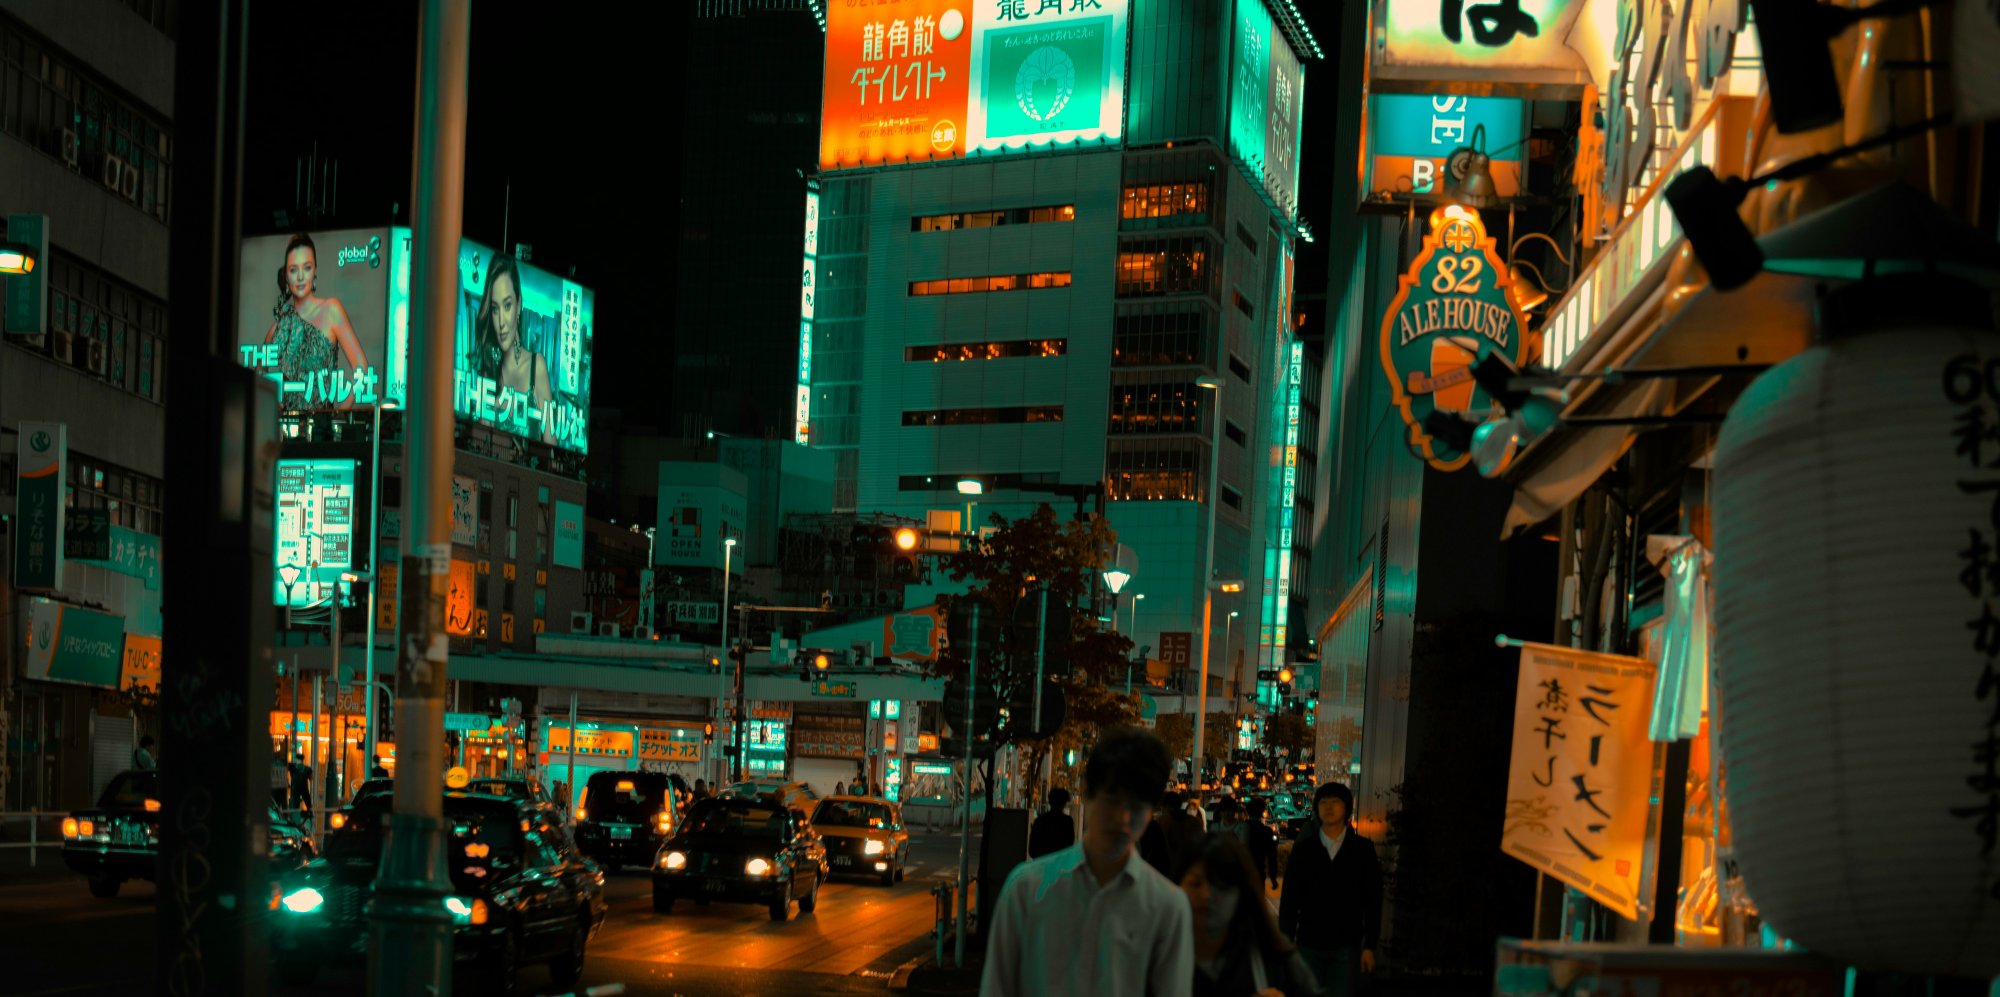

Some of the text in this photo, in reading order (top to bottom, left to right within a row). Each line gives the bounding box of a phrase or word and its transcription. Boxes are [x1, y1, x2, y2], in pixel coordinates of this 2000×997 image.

[863, 15, 936, 62] 龍角散
[851, 60, 947, 106] ダイレクト
[338, 245, 368, 267] global
[1432, 256, 1483, 294] 82
[1401, 298, 1511, 348] ALE HOUSE
[240, 344, 280, 367] THE
[29, 491, 45, 575] りそな銀行
[671, 539, 701, 549] OPEN
[671, 549, 701, 558] HOUSE
[889, 613, 935, 656] 質
[1163, 636, 1186, 649] ユニ
[641, 741, 677, 756] チケット
